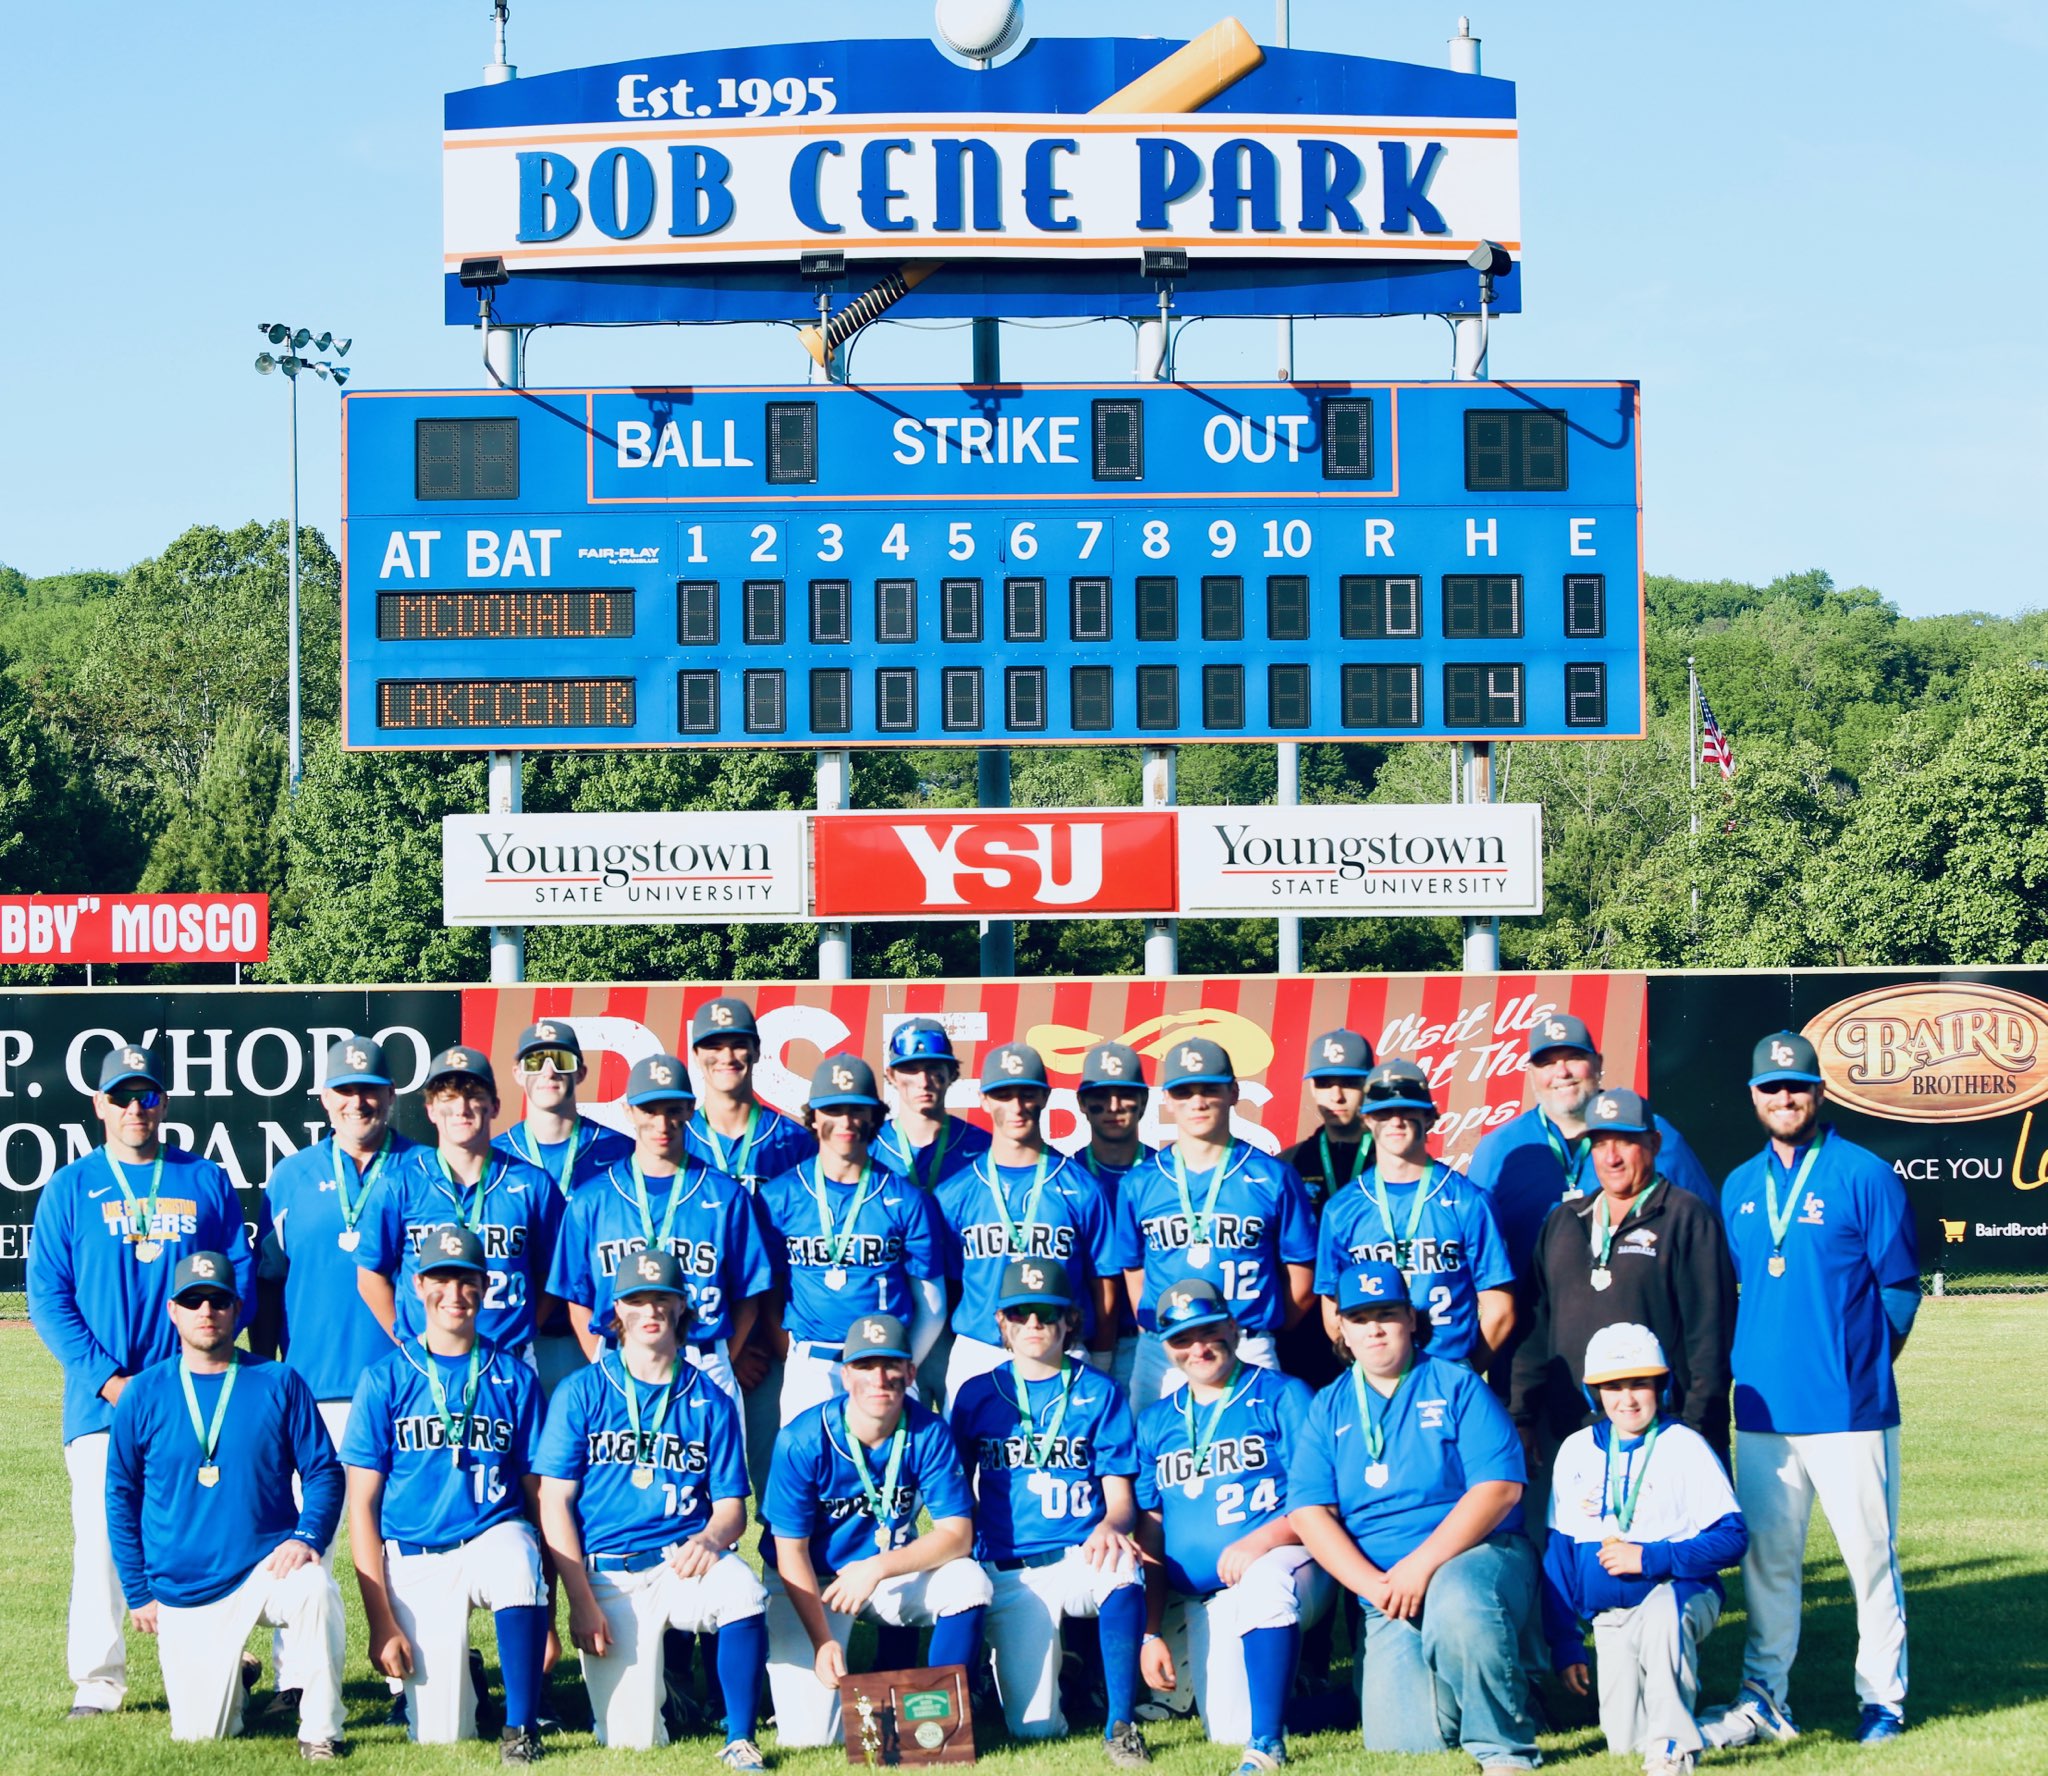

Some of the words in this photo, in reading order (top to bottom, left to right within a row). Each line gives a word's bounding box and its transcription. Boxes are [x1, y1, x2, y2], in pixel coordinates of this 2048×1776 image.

[616, 74, 711, 118] Est.
[717, 77, 837, 117] 1995
[515, 145, 736, 243] BOB
[790, 138, 1081, 233] CENE
[1136, 138, 1450, 234] PARK
[616, 419, 754, 468] BALL
[892, 416, 1080, 465] STRIKE
[1203, 414, 1309, 464] OUT
[379, 530, 441, 578] AT
[467, 529, 562, 577] BAT
[578, 548, 660, 558] FAIR-PLAY
[687, 525, 708, 563] 1
[750, 524, 777, 562] 2
[816, 523, 844, 562] 3
[881, 522, 910, 561] 4
[948, 522, 975, 561] 5
[1010, 521, 1038, 560] 6
[1076, 521, 1103, 559] 7
[1142, 520, 1170, 559] 8
[1208, 519, 1236, 558] 9
[1262, 519, 1312, 558] 10
[1365, 518, 1395, 557] R
[1466, 518, 1497, 556] H
[1569, 518, 1596, 556] E
[400, 593, 612, 637] MCDONALD
[384, 681, 628, 727] LAKECENTR
[476, 833, 772, 888] Youngstown
[890, 823, 1105, 905] YSU
[1212, 824, 1508, 880] Youngstown
[535, 887, 604, 903] STATE
[627, 884, 773, 902] UNIVERSITY
[1271, 878, 1339, 895] STATE
[1363, 876, 1508, 894] UNIVERSITY
[112, 903, 257, 954] MOSCO
[1376, 1002, 1491, 1056] Visit
[1494, 994, 1557, 1035] Us
[1834, 1008, 2039, 1085] BAIRD
[1468, 1039, 1530, 1082] The
[1912, 1075, 2017, 1095] BROTHERS
[1426, 1101, 1520, 1147] ops
[1947, 1158, 2003, 1180] YOU
[598, 1237, 717, 1277] TIRS
[961, 1221, 1075, 1260] TIGERS
[1219, 1260, 1260, 1300] 12
[1428, 1286, 1452, 1326] 2
[1041, 1478, 1092, 1519] 00
[1215, 1478, 1280, 1526] 24
